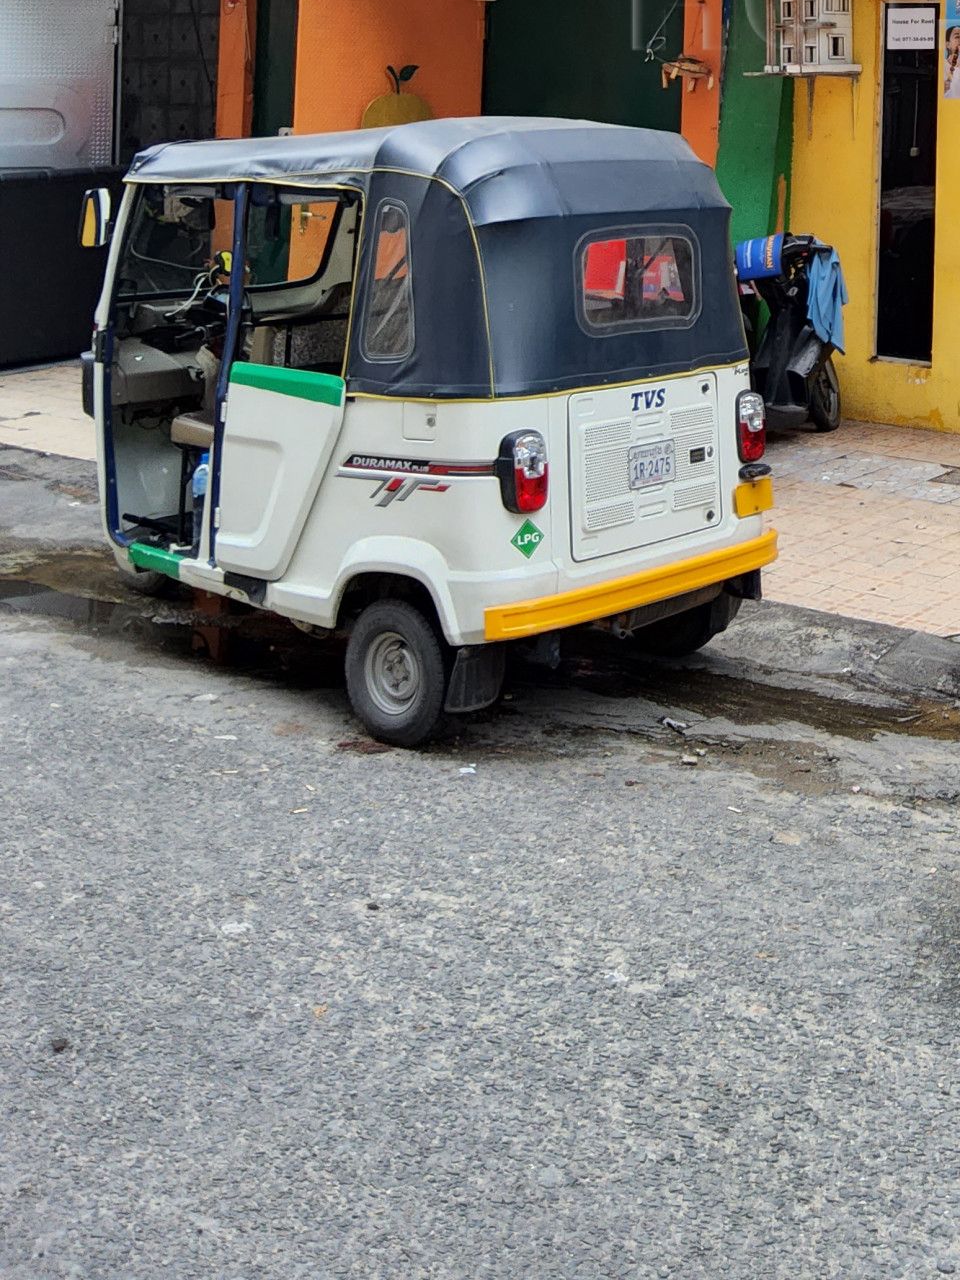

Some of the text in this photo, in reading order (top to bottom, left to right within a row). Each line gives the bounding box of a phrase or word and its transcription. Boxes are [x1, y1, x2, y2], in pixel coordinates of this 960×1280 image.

[631, 388, 665, 411] TVS
[352, 457, 412, 471] DURAMAX
[517, 532, 540, 545] LPG
